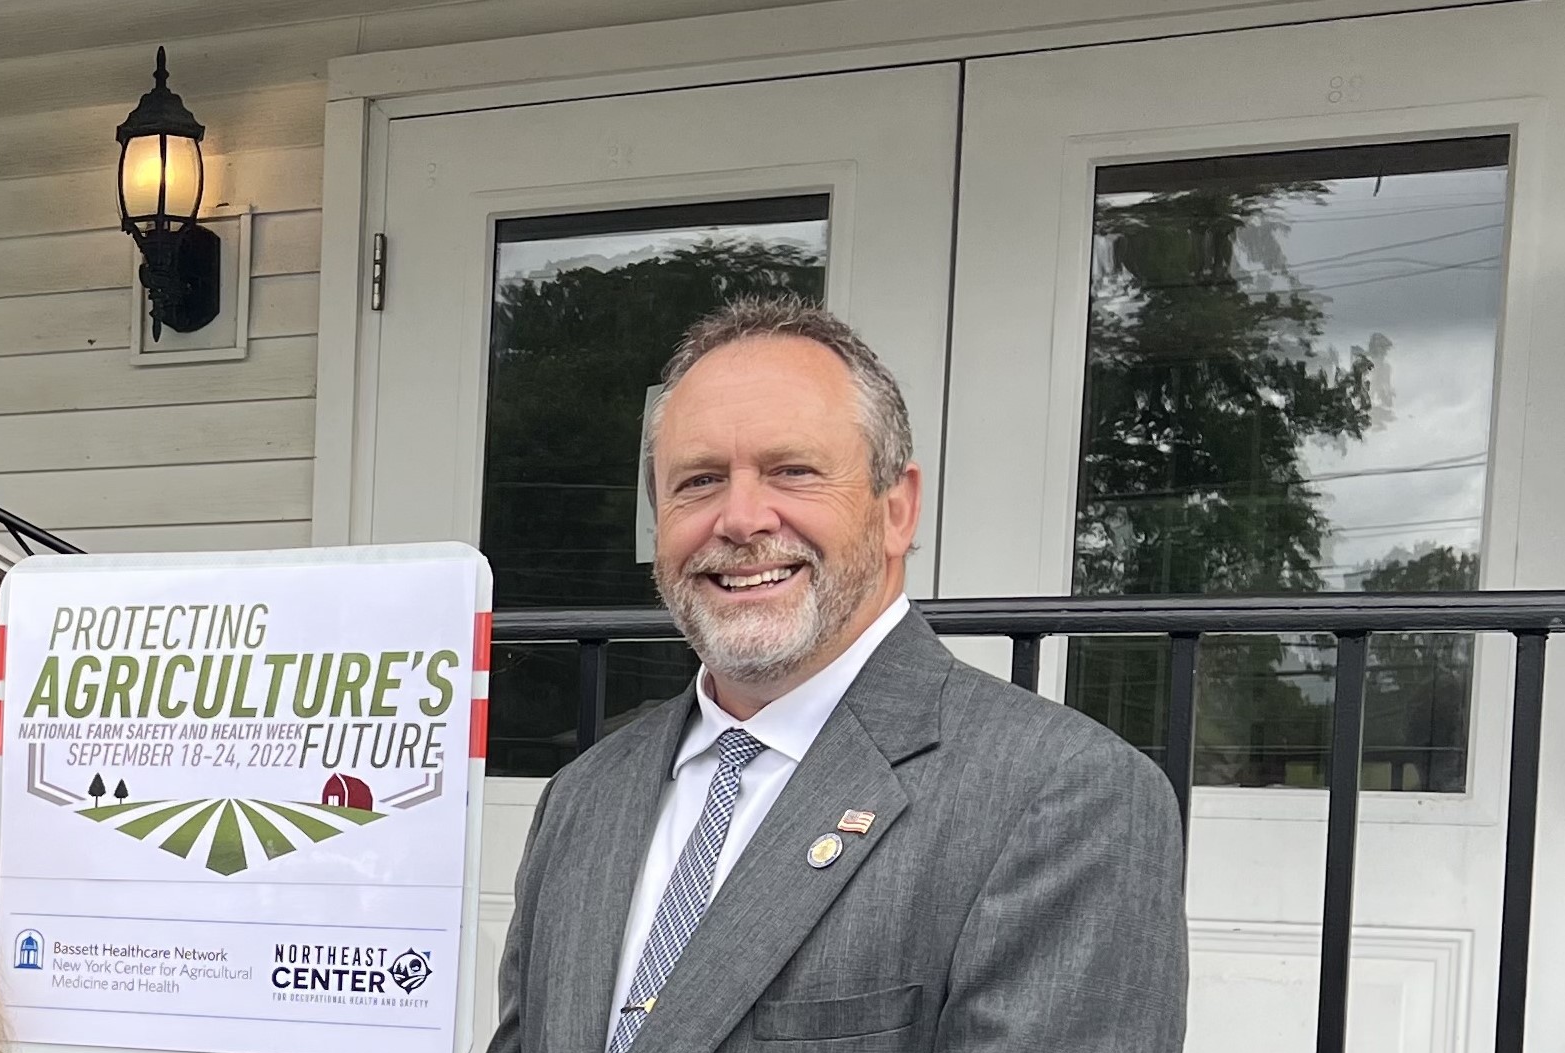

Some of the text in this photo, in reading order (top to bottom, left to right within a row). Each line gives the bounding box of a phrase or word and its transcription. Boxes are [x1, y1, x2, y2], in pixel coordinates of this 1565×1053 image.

[48, 603, 269, 651] PROTECTING
[23, 650, 459, 719] AGRICULTURE'S
[18, 723, 304, 741] NATIONAL FARM SAFETY AND HEALTH WEEK
[66, 743, 174, 767] SEPTEMBER
[246, 743, 298, 766] 2022
[298, 723, 447, 769] FUTURE
[53, 941, 229, 961] Bassett Healthcare Network
[274, 943, 388, 968] NORTHEAST
[52, 958, 253, 981] New York Center for Agricultural
[271, 966, 386, 993] CENTER
[51, 975, 180, 993] Medicine and Health
